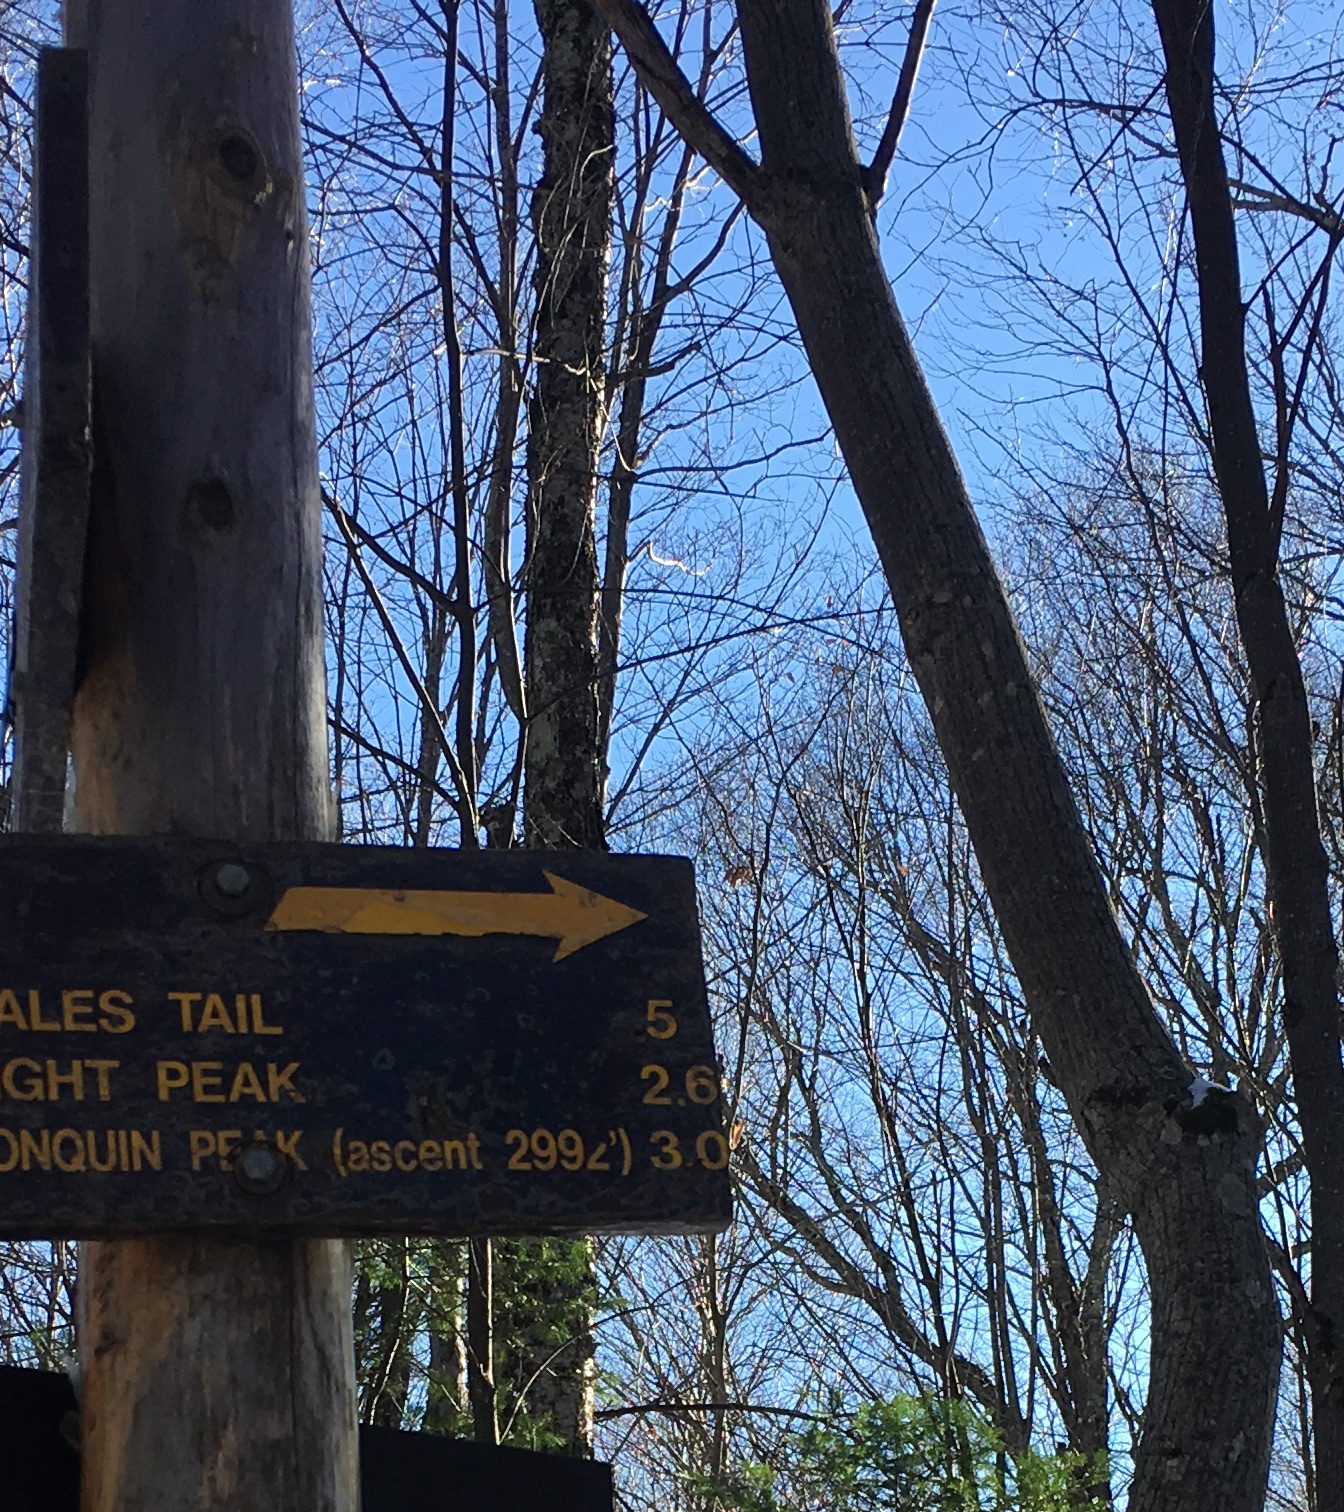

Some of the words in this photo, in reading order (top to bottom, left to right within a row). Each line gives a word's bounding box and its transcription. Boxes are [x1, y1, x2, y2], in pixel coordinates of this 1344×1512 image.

[168, 992, 284, 1035] TAIL
[156, 1060, 306, 1103] PEAK
[640, 1064, 719, 1105] 2.6
[189, 1130, 306, 1171] PEK
[333, 1127, 483, 1177] (ascent
